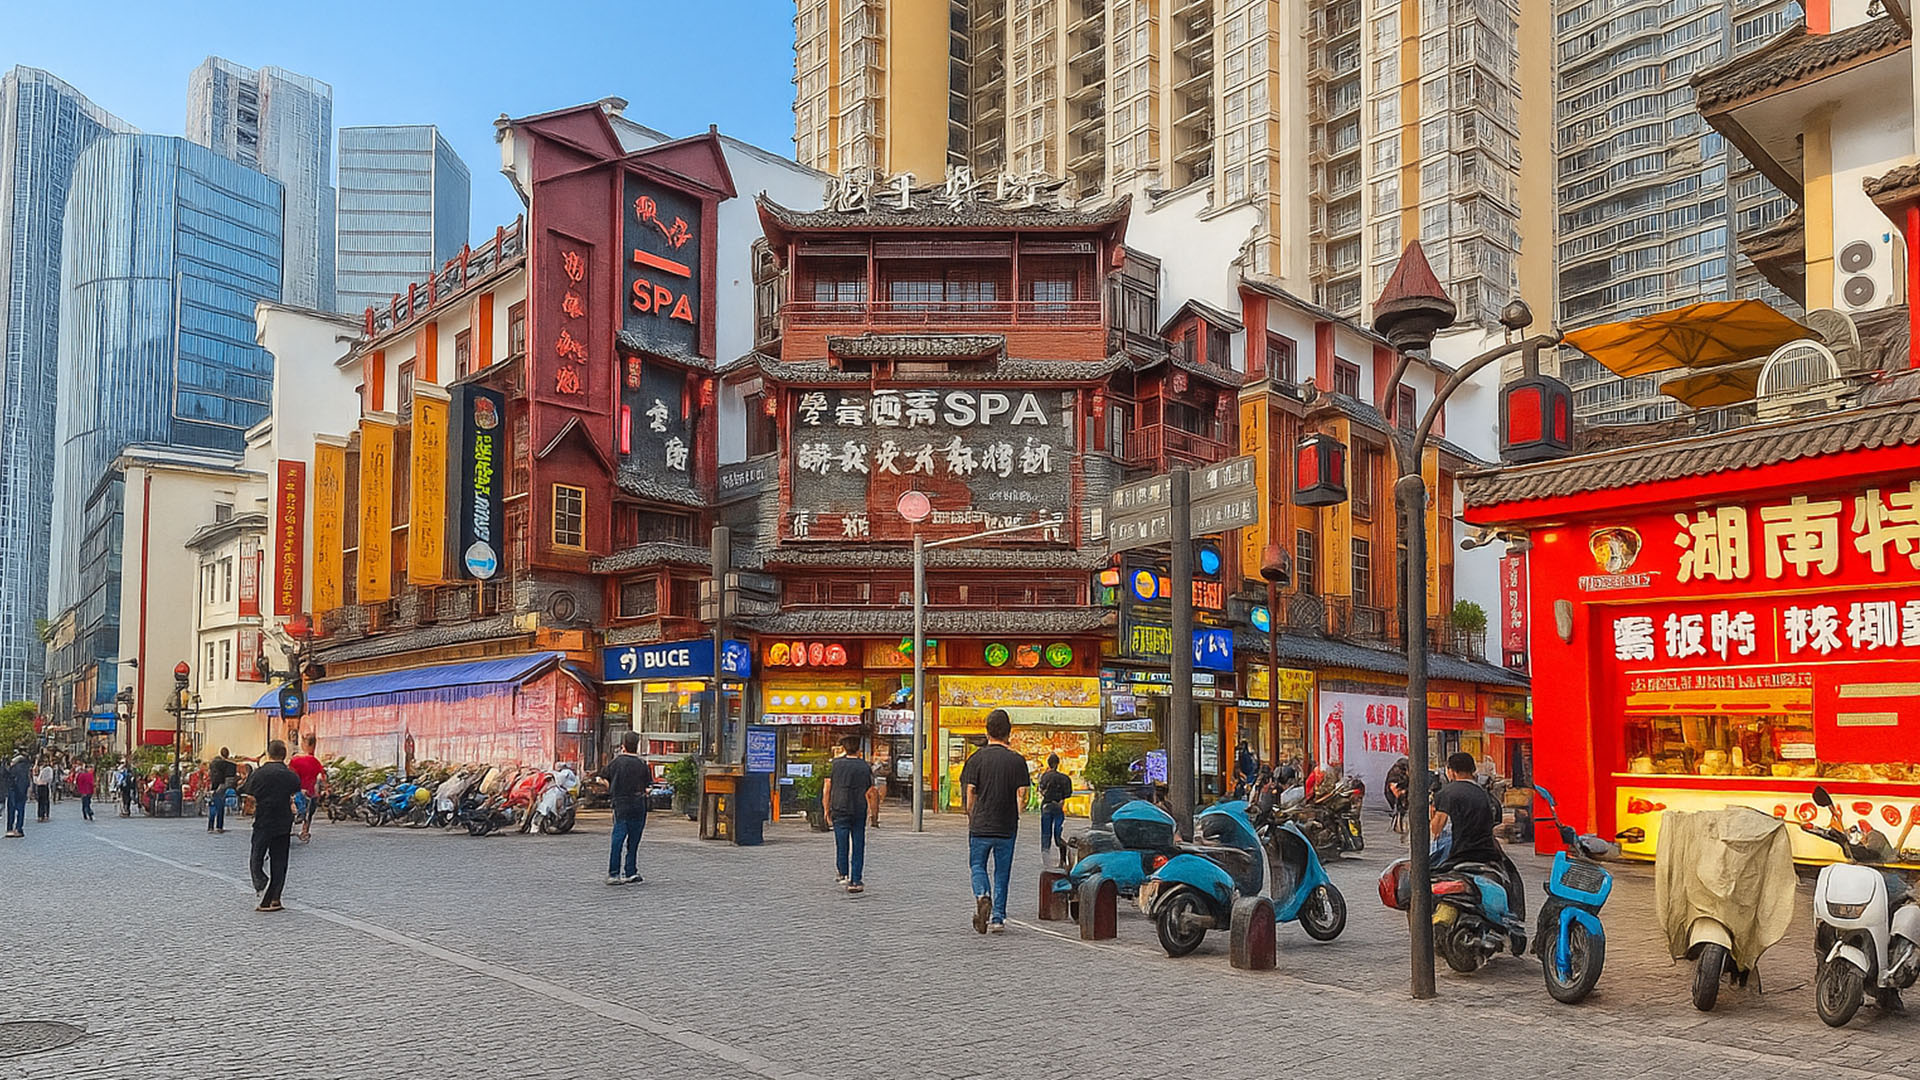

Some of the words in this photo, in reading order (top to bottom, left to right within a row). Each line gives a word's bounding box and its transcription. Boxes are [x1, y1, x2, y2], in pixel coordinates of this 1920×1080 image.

[633, 280, 693, 322] SPA
[943, 392, 1048, 426] SPA
[644, 649, 690, 668] BUCE
